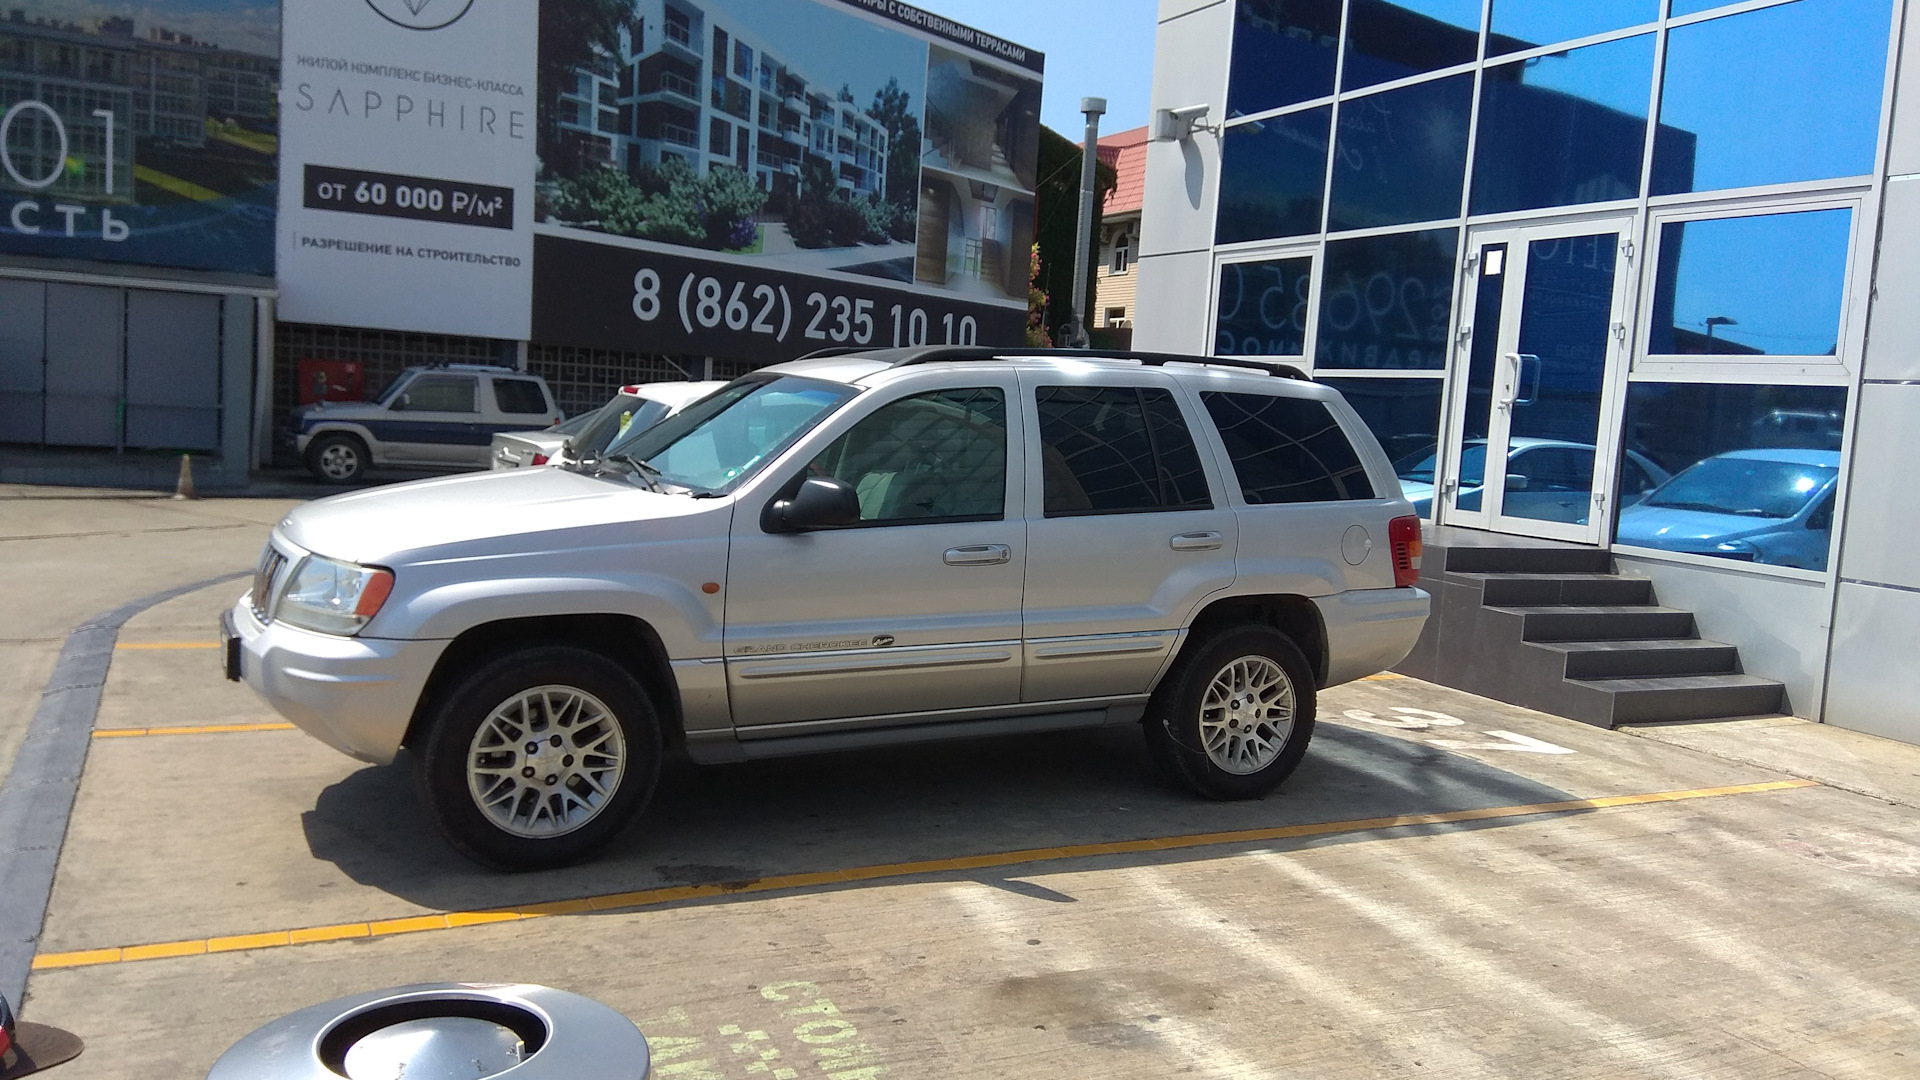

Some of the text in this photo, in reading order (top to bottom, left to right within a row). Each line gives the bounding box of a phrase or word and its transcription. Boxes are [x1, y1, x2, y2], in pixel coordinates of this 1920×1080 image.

[888, 2, 897, 15] С
[897, 4, 974, 43] СОБСТВЕННЫМИ
[976, 33, 1026, 62] ТЕРРАСАМИ
[297, 54, 524, 96] ЖИЛОЙ КОМПЛЕКС БИЗНЕС-КЛАССА
[296, 82, 524, 139] SAPPHIRE
[0, 100, 114, 195] 01
[354, 180, 387, 204] 60
[395, 185, 443, 212] 000
[10, 200, 130, 242] СТЬ
[302, 236, 521, 268] РАЗРЕШЕНИЕ НА СТРОИТЕЛЬСТВО
[632, 268, 978, 348] 8 (862) 235 10 10
[734, 643, 787, 655] GRAND
[790, 639, 868, 652] CHEROKEE
